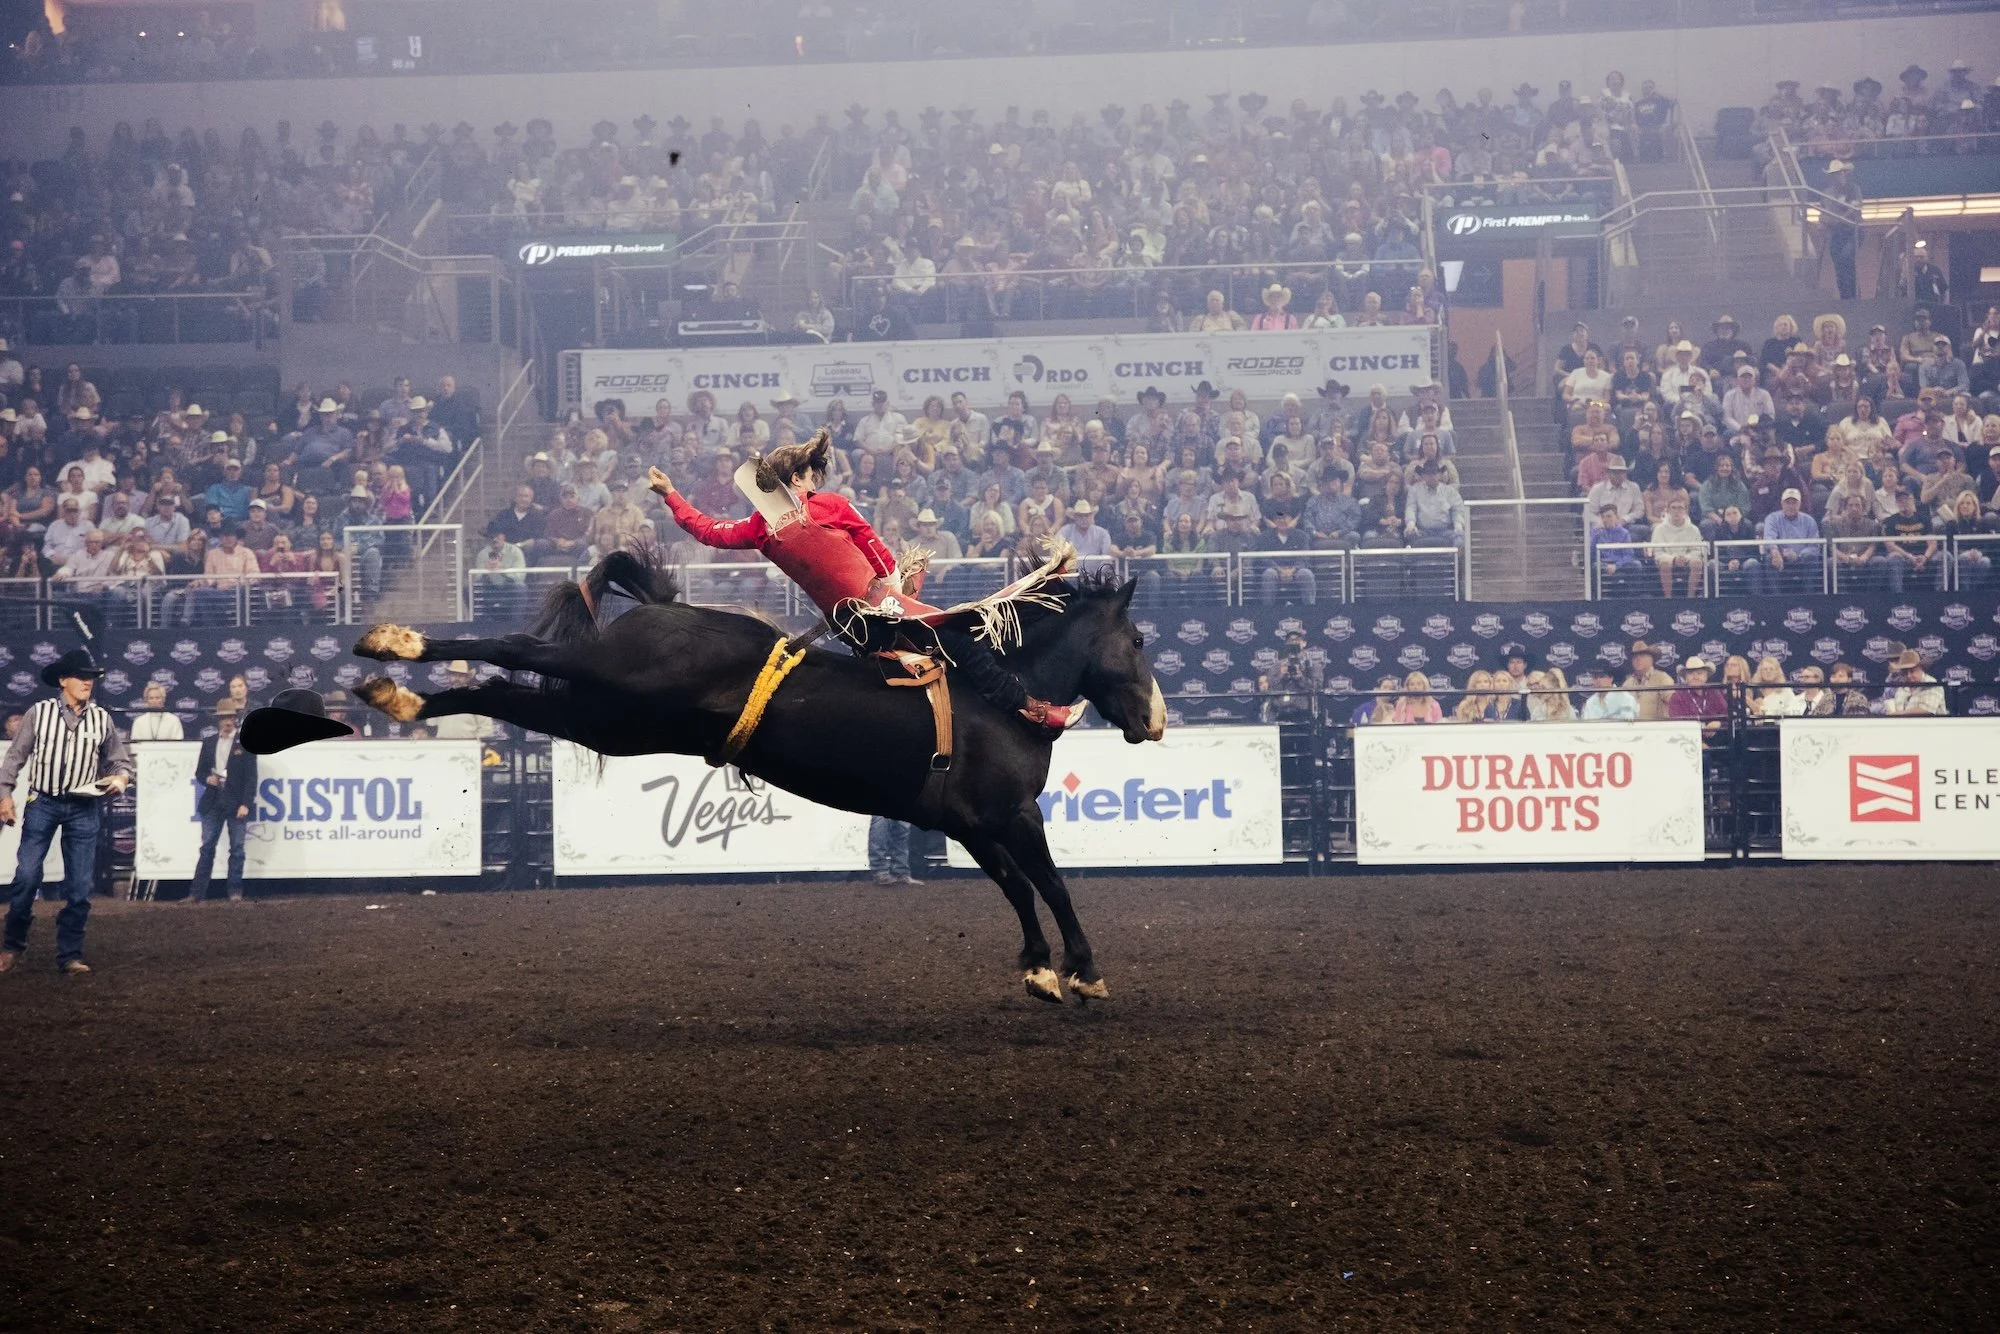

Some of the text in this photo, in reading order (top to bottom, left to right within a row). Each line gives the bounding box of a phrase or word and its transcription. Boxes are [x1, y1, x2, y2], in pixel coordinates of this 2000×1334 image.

[1482, 217, 1507, 228] First
[1508, 215, 1562, 227] PREMIER
[556, 245, 612, 257] PREMIER
[1114, 360, 1204, 377] CINCH
[1227, 356, 1304, 370] RODEO
[1329, 354, 1420, 371] CINCH
[594, 374, 670, 387] RODEO
[693, 372, 780, 389] CINCH
[903, 366, 991, 383] CINCH
[1046, 368, 1088, 383] RDO
[1421, 751, 1633, 791] DURANGO
[1934, 769, 1999, 785] SILE
[190, 777, 422, 823] SISTOL
[1035, 771, 1232, 822] riefert
[641, 769, 792, 851] Vegas
[1456, 795, 1600, 833] BOOTS
[284, 825, 422, 841] best all-around
